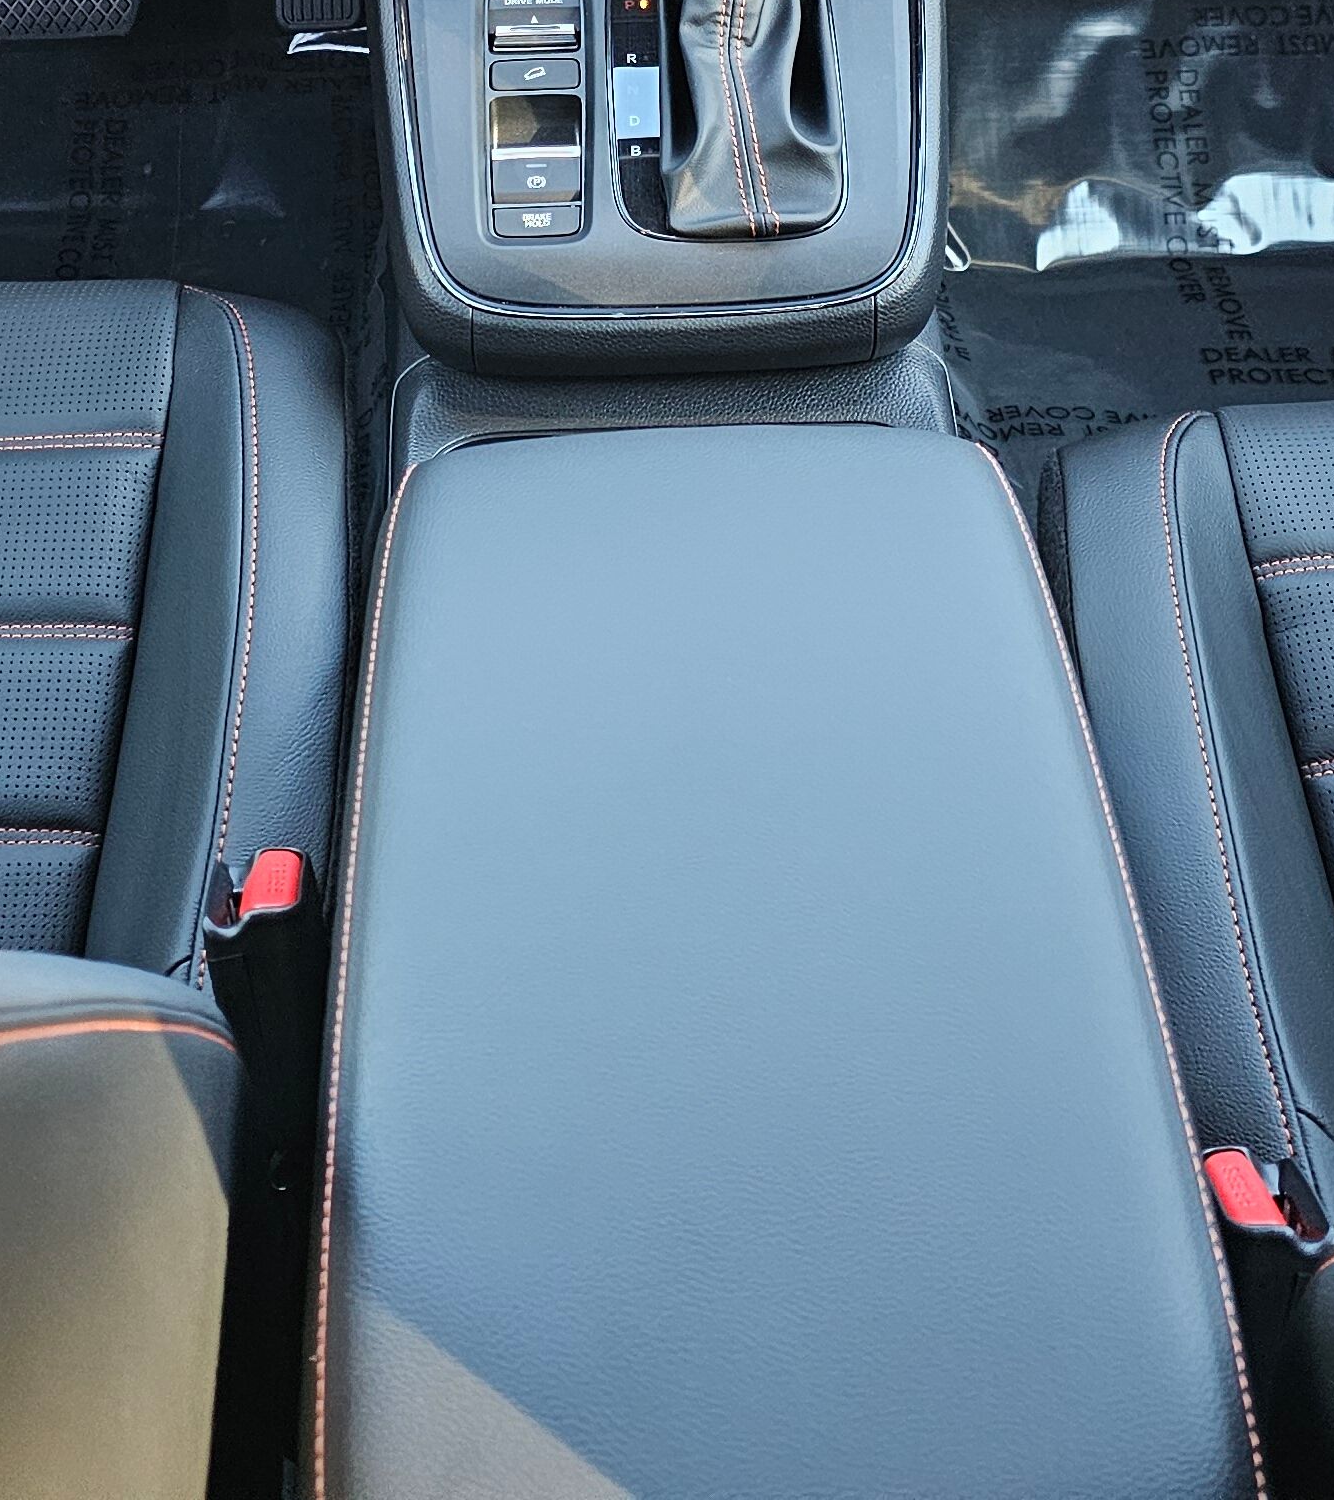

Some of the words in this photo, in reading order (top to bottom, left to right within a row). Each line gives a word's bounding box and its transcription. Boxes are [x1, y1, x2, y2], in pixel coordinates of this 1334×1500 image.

[624, 0, 635, 10] P
[626, 53, 637, 64] R
[629, 115, 640, 127] D
[630, 145, 642, 157] B
[1199, 345, 1315, 366] DEALER
